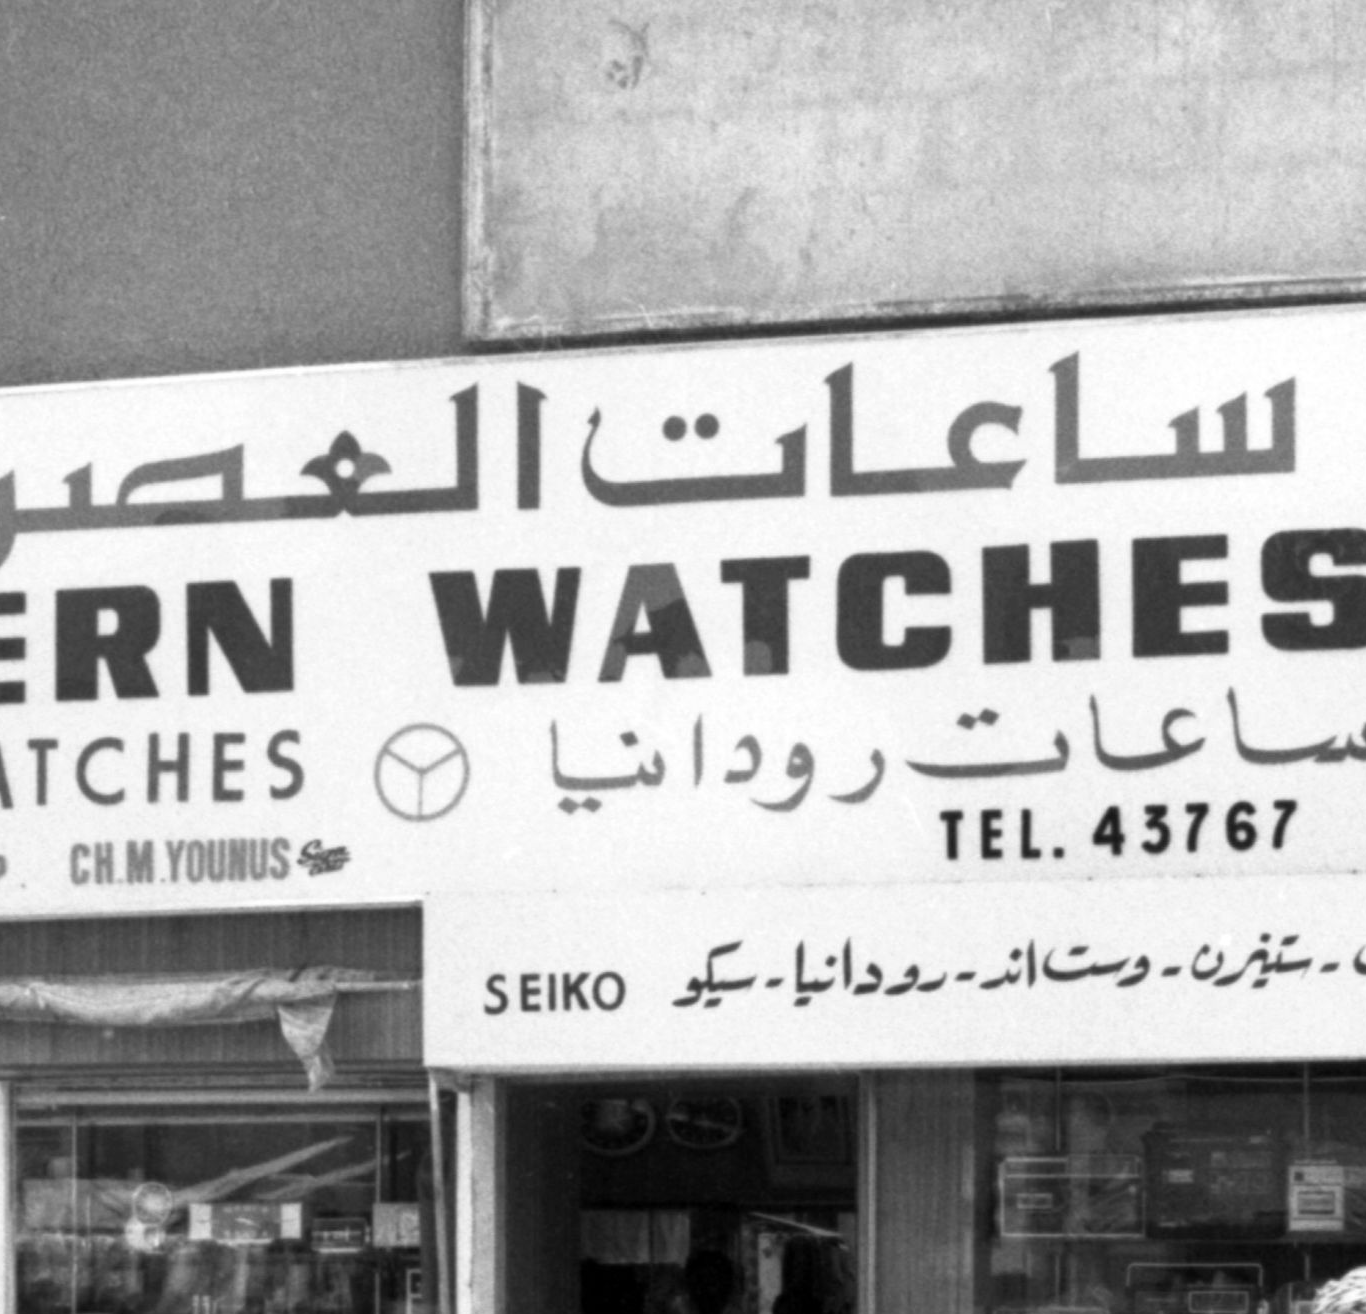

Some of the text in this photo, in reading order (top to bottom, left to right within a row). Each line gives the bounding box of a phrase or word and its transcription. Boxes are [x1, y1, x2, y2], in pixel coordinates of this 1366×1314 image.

[581, 350, 1297, 508] ساعات
[549, 713, 886, 815] رودانيا
[939, 799, 1298, 862] TEL. 43767
[484, 971, 626, 1015] SEIKO
[672, 941, 758, 1008] سيكو
[793, 941, 948, 1007] رودانيا
